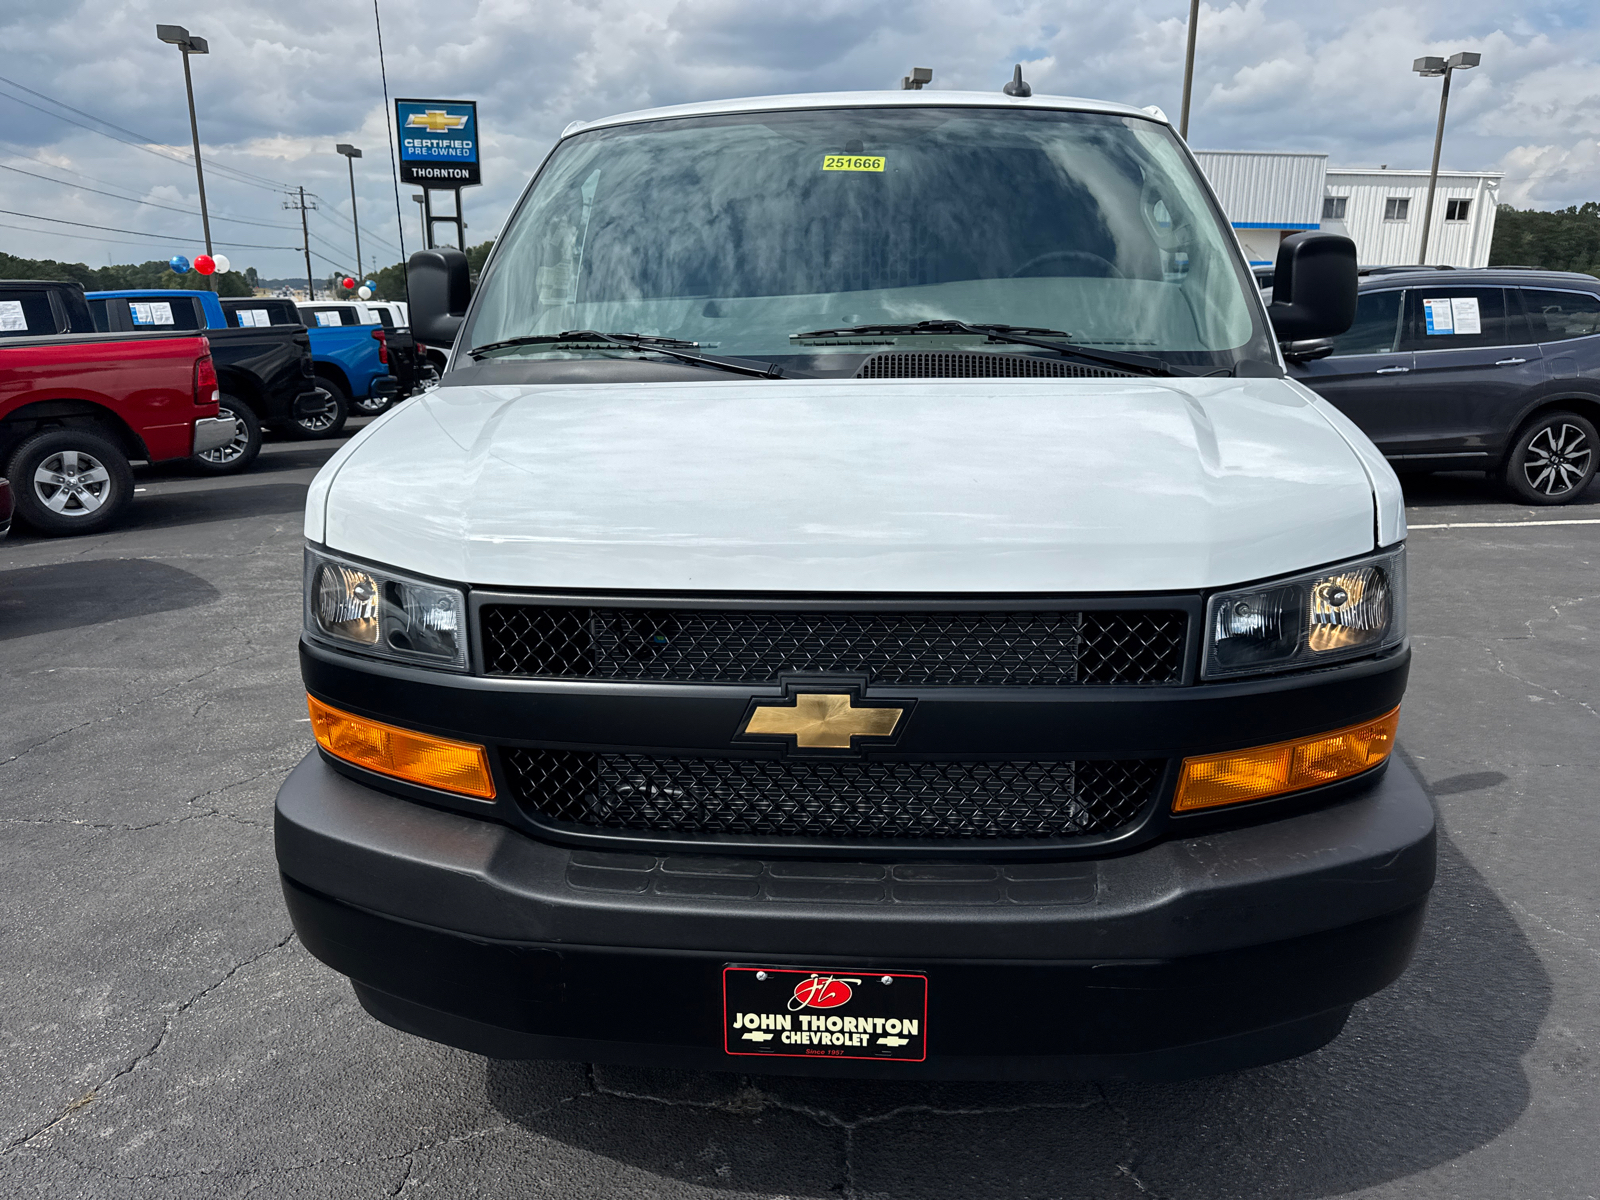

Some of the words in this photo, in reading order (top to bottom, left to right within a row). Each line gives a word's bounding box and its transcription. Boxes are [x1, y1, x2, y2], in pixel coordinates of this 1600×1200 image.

[404, 139, 472, 148] CERTIFIED
[408, 147, 470, 156] PRE-OWNED
[825, 157, 881, 168] 251666
[412, 168, 470, 178] THORNTON
[733, 1012, 792, 1031] JOHN
[799, 1014, 919, 1036] THORNTON
[781, 1030, 870, 1047] CHEVROLET
[805, 1048, 826, 1056] Since
